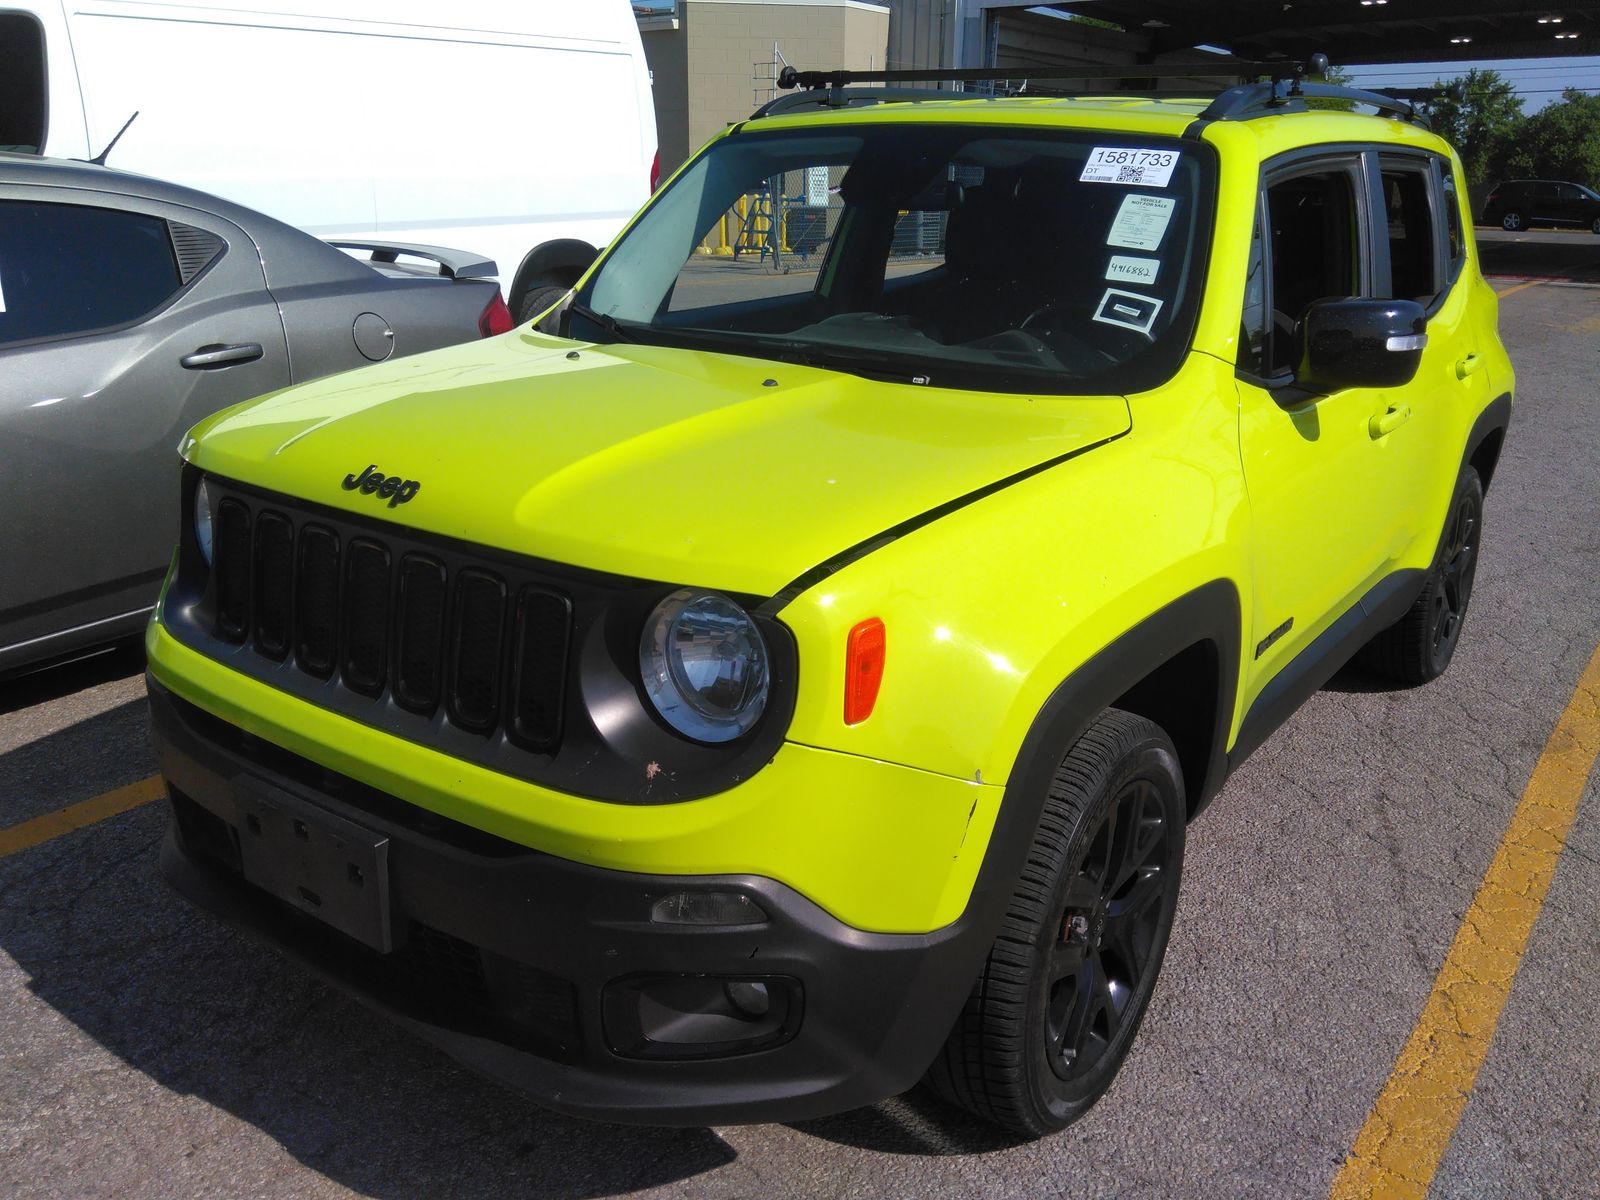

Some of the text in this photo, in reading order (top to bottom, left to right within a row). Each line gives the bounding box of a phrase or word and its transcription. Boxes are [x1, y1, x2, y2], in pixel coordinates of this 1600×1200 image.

[1098, 151, 1172, 167] 1581733
[1111, 263, 1151, 277] 4916882
[341, 464, 421, 509] Jeep
